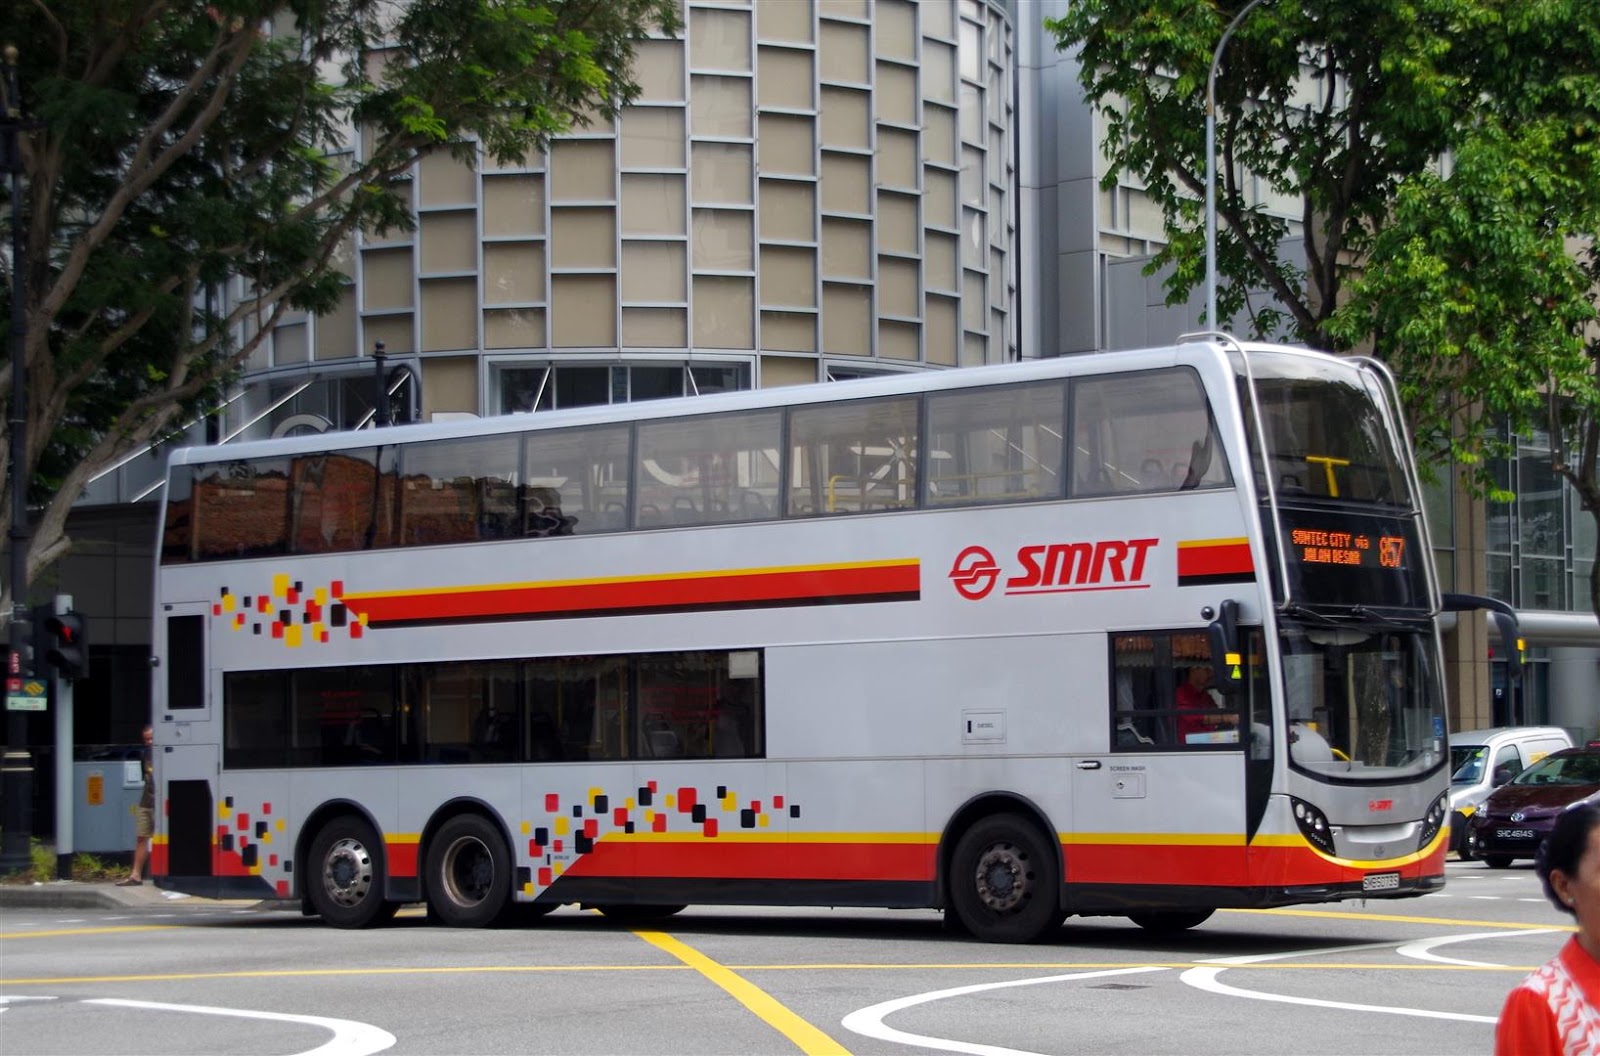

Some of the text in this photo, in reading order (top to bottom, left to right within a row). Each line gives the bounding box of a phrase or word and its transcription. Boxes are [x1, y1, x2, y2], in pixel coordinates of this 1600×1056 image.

[1291, 529, 1328, 546] SUNTEC
[1329, 533, 1351, 548] CITY
[1006, 538, 1159, 588] SMRT
[1379, 536, 1405, 567] 857
[1496, 829, 1534, 838] SHC4614S
